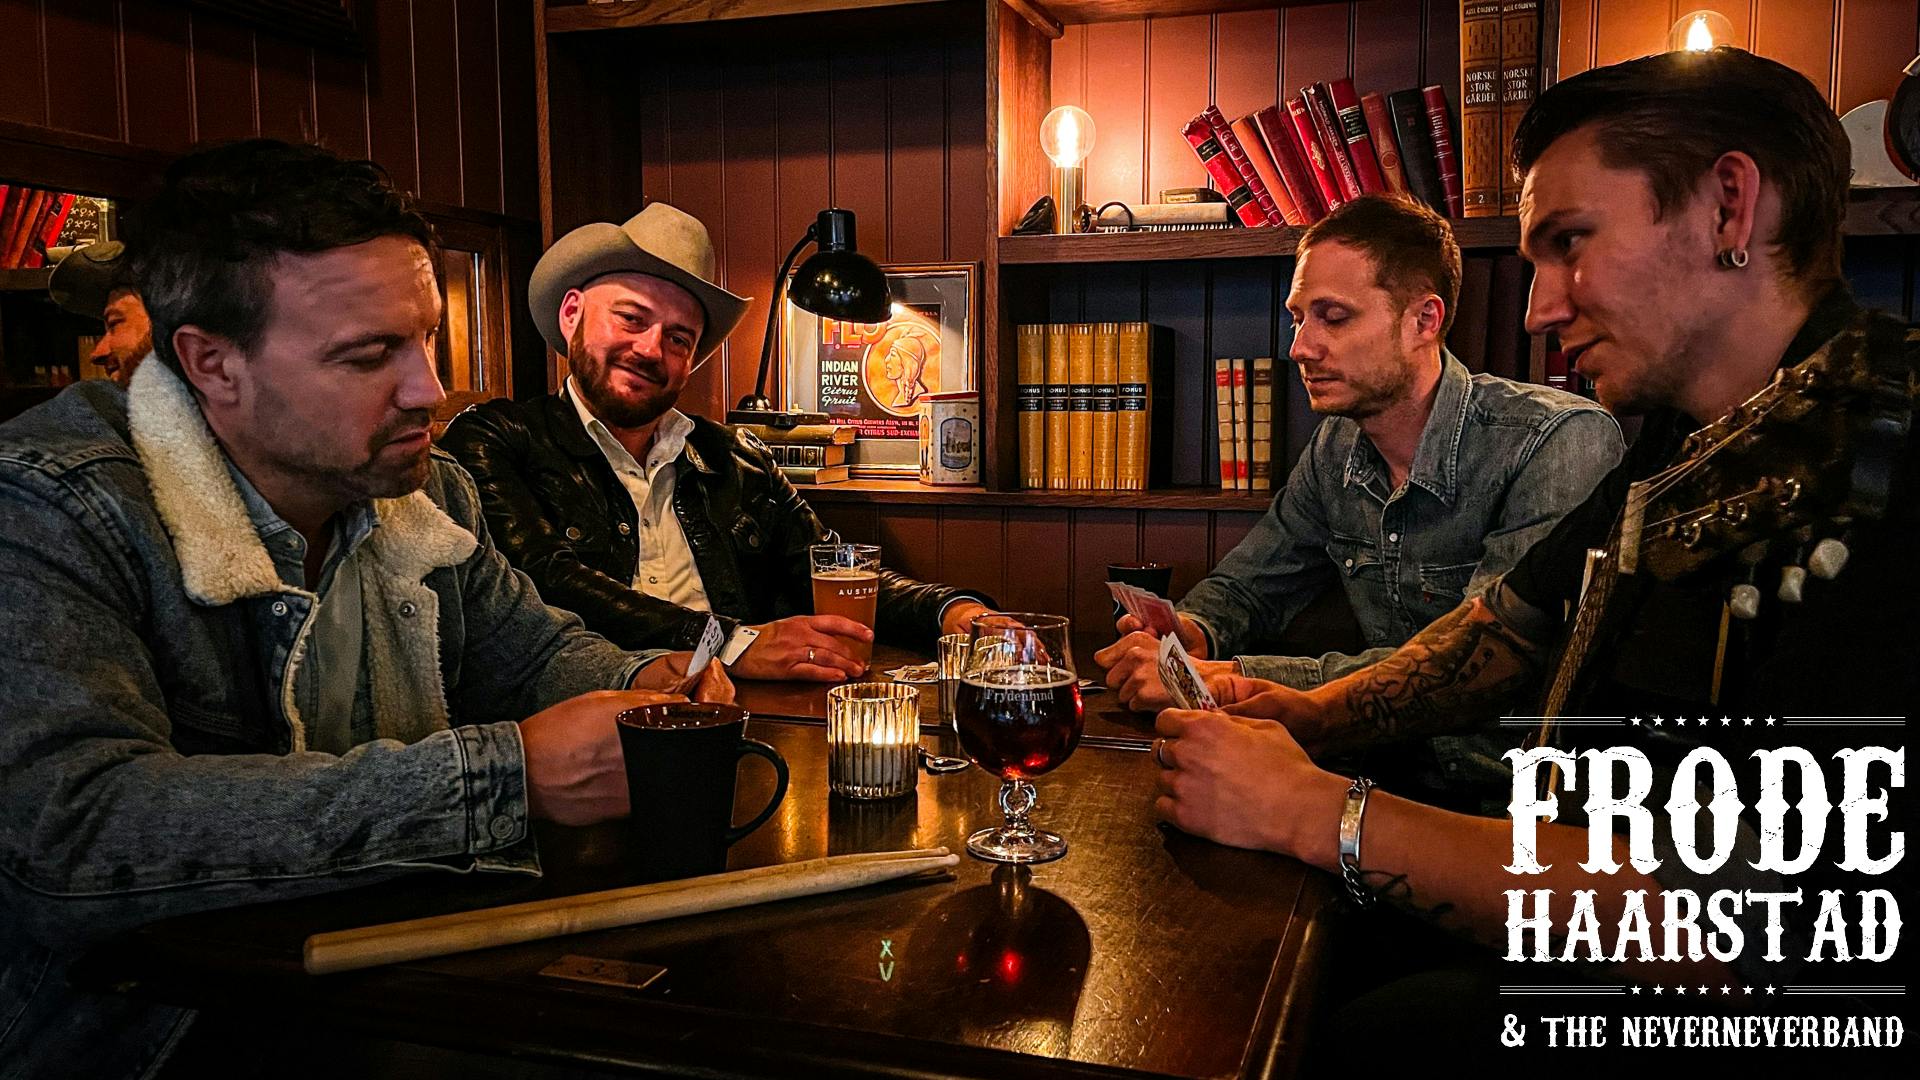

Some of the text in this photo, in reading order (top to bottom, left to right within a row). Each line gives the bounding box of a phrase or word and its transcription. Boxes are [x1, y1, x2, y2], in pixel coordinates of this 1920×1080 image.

[1466, 71, 1497, 82] NORSKE
[1479, 195, 1484, 204] 2
[821, 360, 859, 373] INDIAN
[821, 374, 859, 386] RIVER
[822, 386, 859, 395] Citrus
[821, 395, 857, 407] Fruit
